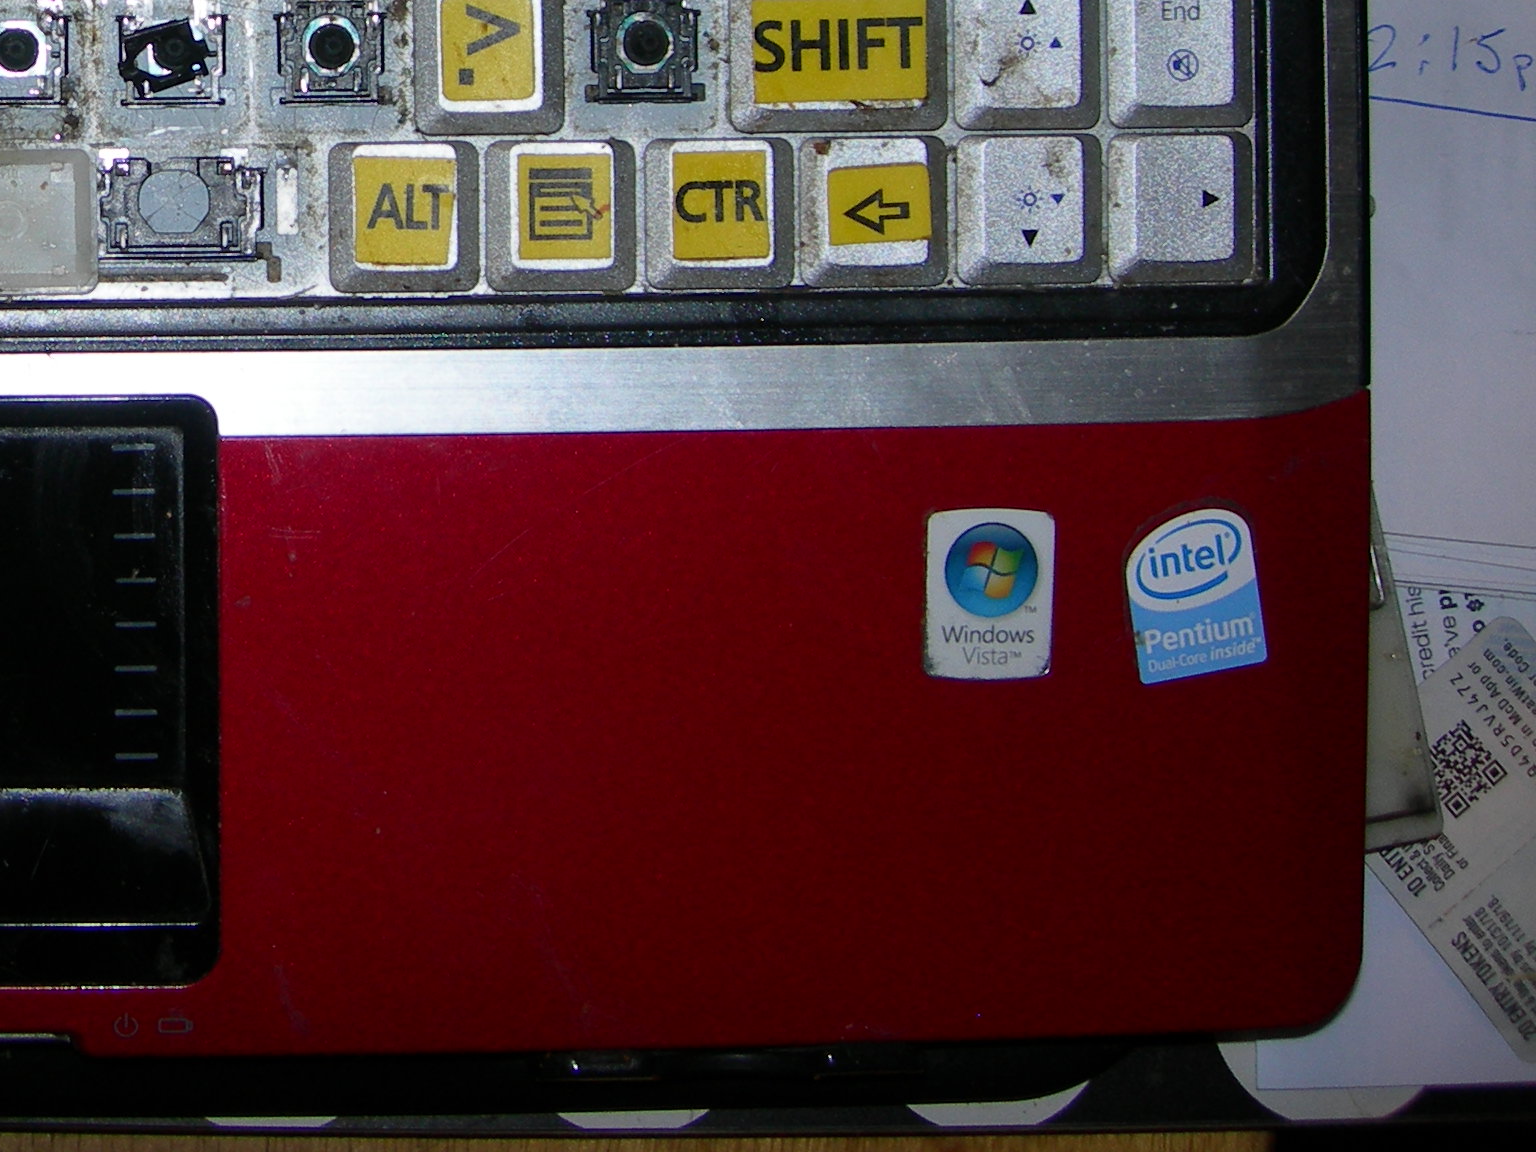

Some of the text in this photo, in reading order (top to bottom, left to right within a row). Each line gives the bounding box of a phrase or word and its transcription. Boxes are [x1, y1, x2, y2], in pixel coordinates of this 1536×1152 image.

[1162, 0, 1202, 21] End
[753, 16, 924, 74] SHIFT
[367, 183, 451, 232] ALT
[674, 180, 765, 224] CTR
[1148, 532, 1226, 581] intel
[941, 624, 1035, 644] Windows
[1143, 615, 1255, 655] Pentium
[1148, 652, 1209, 674] Dual-Core
[1479, 674, 1503, 700] App
[1406, 876, 1427, 897] 10
